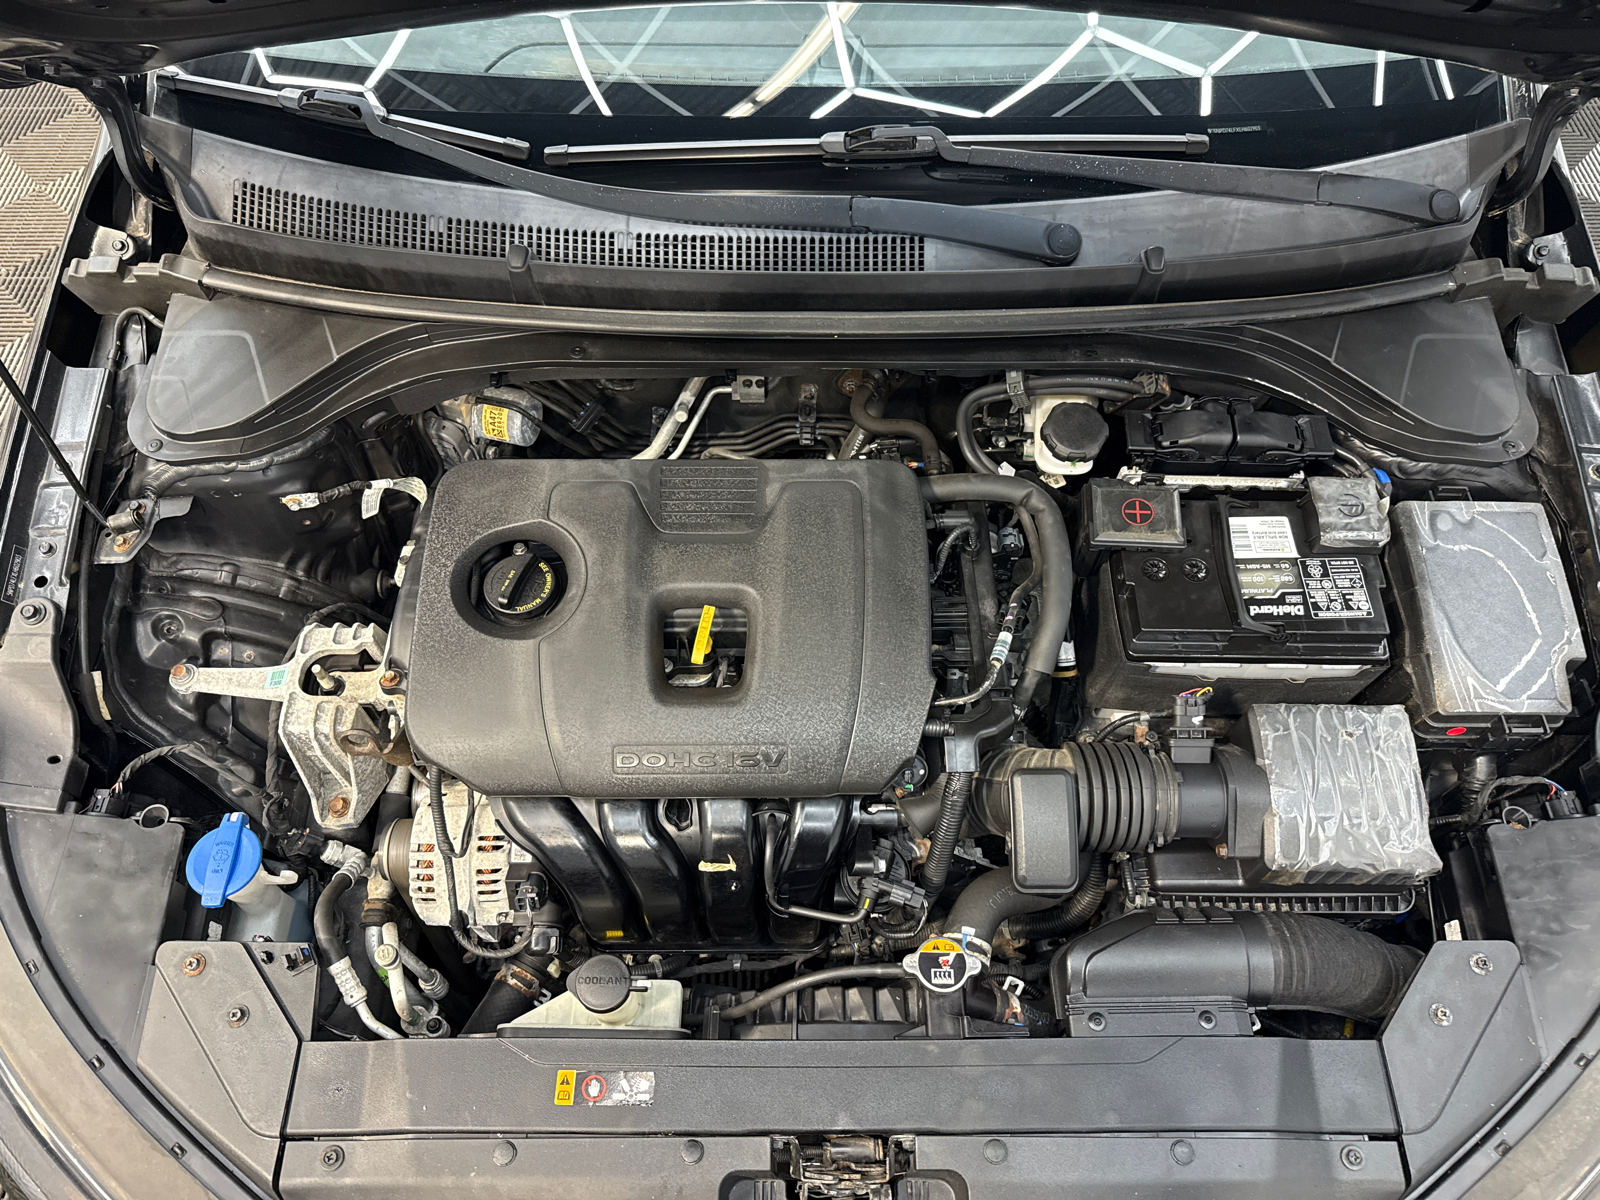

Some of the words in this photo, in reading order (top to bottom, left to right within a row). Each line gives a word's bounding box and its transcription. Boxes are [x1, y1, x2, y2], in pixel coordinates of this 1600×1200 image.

[489, 410, 497, 428] A47
[538, 562, 549, 572] SEE
[541, 573, 552, 598] OWNER'S
[515, 598, 541, 612] MANUAL
[1249, 604, 1305, 616] DieHard
[616, 751, 717, 768] DOHC
[726, 749, 786, 768] 16V
[577, 975, 630, 985] COOLANT
